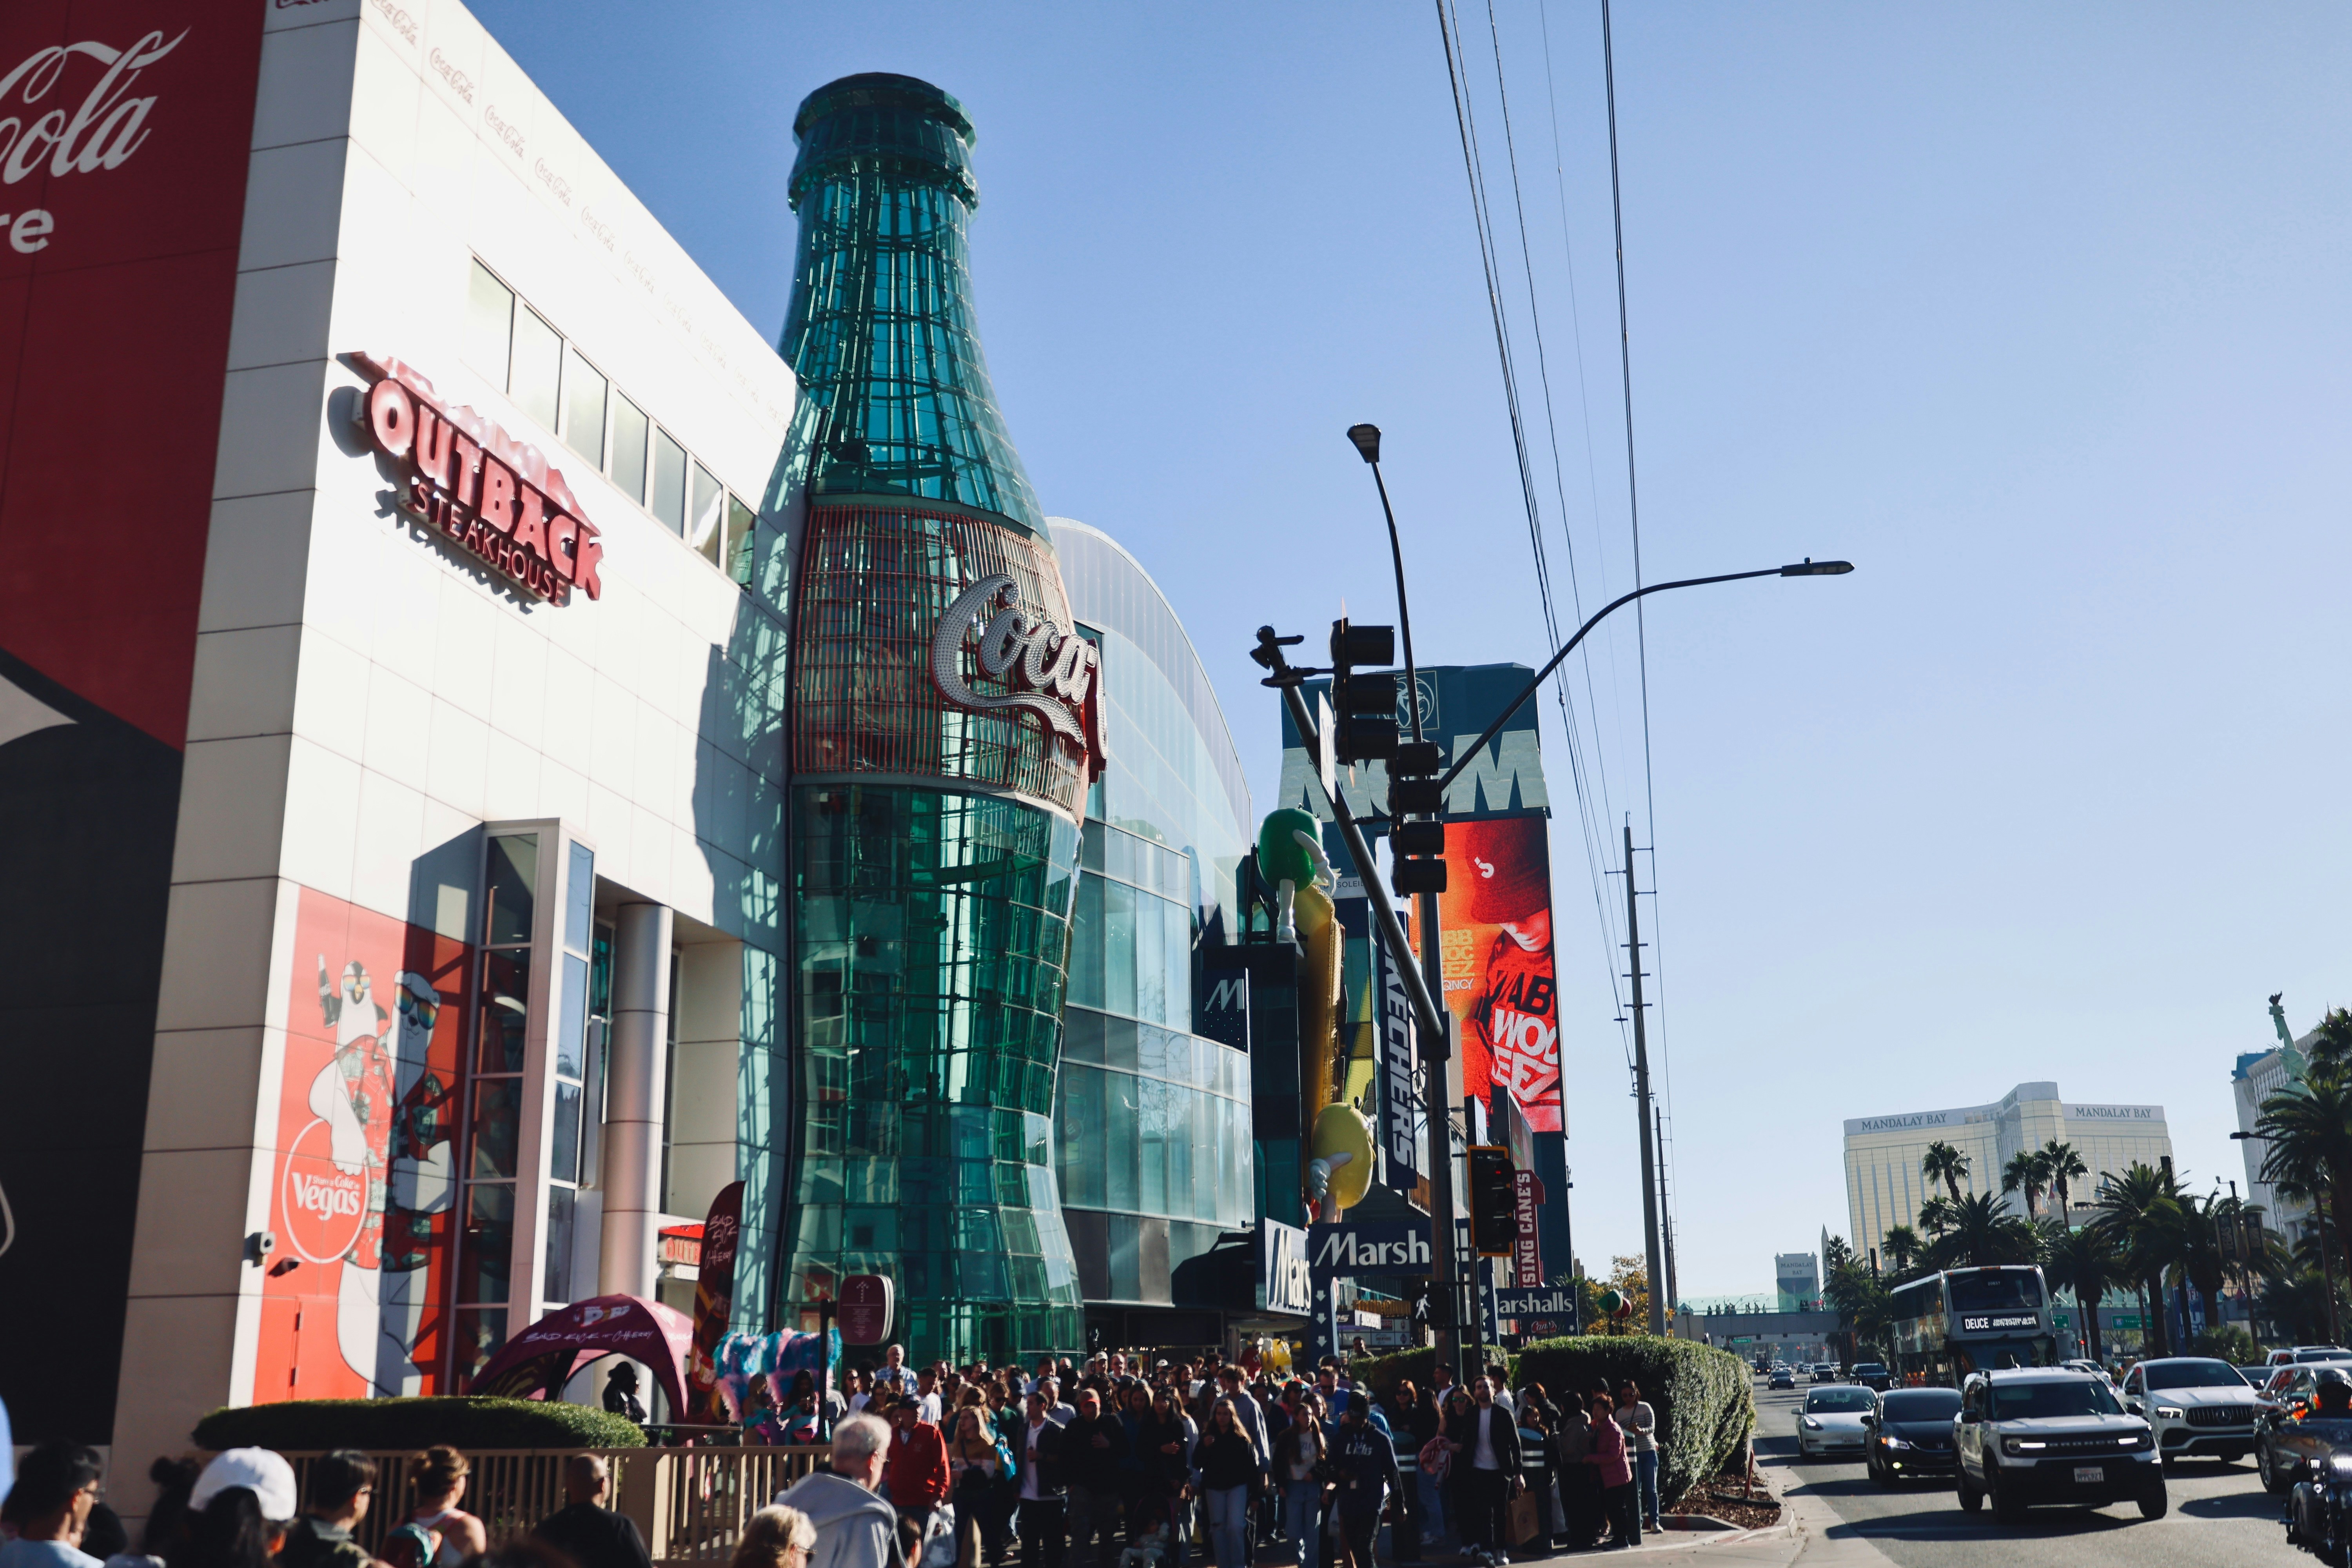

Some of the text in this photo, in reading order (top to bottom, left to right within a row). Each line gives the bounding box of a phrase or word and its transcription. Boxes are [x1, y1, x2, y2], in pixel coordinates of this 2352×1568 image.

[370, 0, 419, 50] ca-Cola
[430, 47, 474, 108] Coca-Cola
[485, 104, 525, 160] Coca-Cola
[535, 157, 572, 209] Coca-Cola
[371, 379, 604, 601] OUTBACK
[414, 482, 570, 607] STEAKHOUSE
[1862, 1113, 1947, 1131] MANDALAY BAY
[2076, 1107, 2151, 1119] MANDALAY BAY
[291, 1172, 361, 1221] Vegas
[335, 1175, 354, 1189] Coke
[1516, 1173, 1533, 1234] CANE'S
[1495, 1292, 1573, 1313] arshalls
[1965, 1318, 1989, 1329] DEUCE
